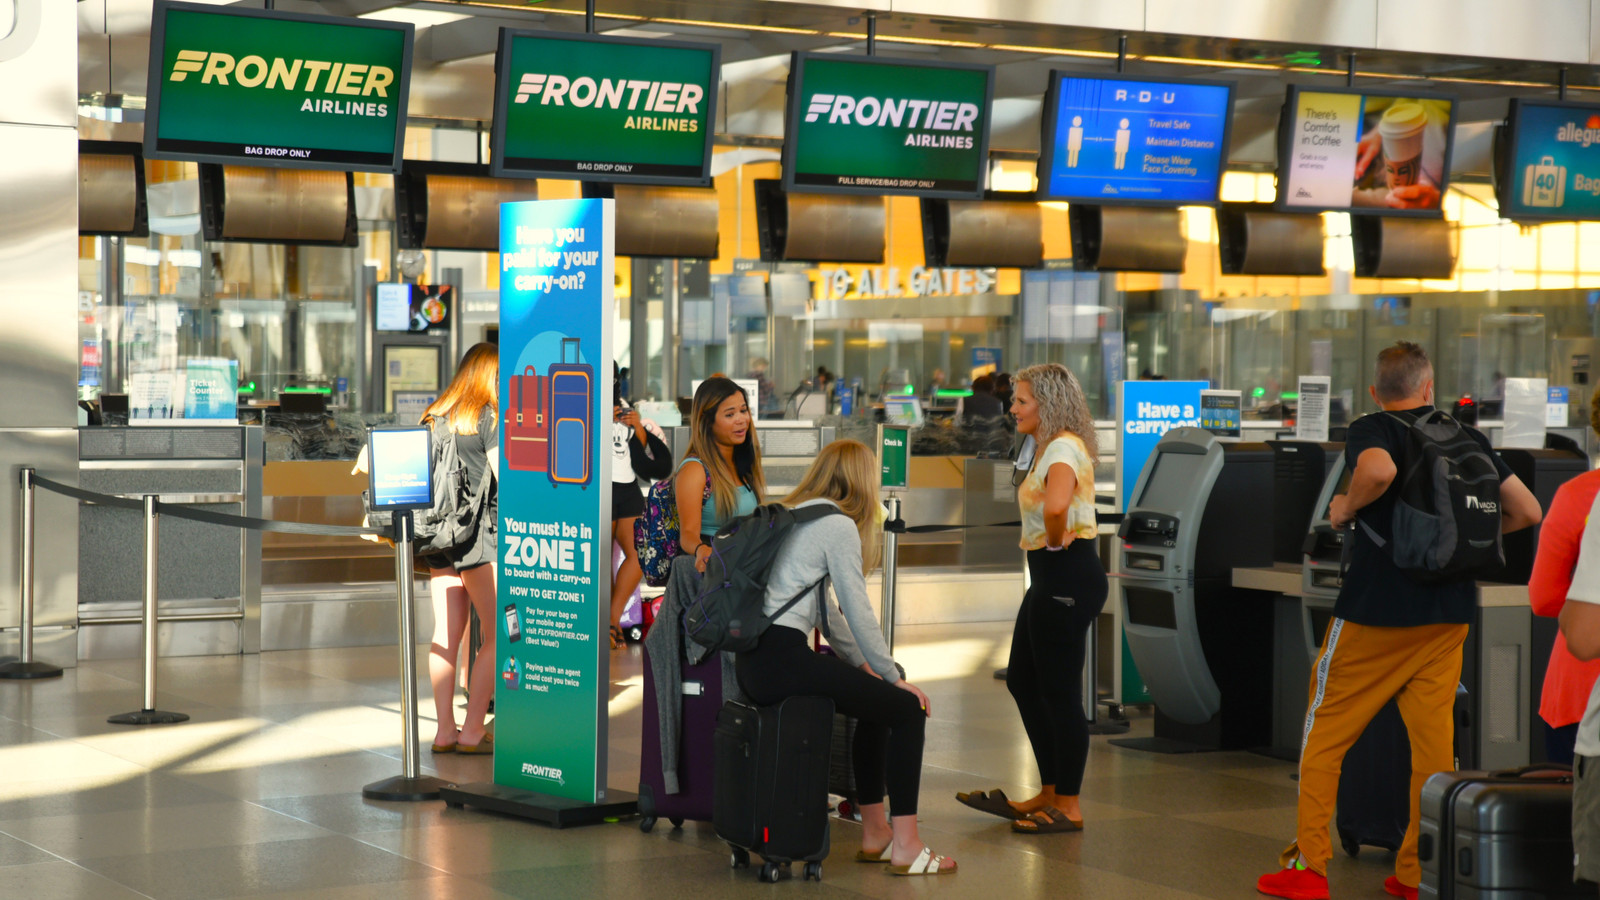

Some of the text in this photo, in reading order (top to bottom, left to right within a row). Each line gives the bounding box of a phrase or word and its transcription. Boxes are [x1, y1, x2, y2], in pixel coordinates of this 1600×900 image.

[170, 49, 394, 98] FRONTIER
[514, 73, 704, 114] FRONTIER
[300, 98, 388, 117] AIRLINES
[805, 94, 978, 131] FRONTIER
[1305, 108, 1337, 120] There's
[624, 116, 698, 132] AIRLINES
[1148, 119, 1191, 130] Travel Safe
[1303, 122, 1340, 133] Comfort
[905, 134, 974, 149] AIRLINES
[1146, 137, 1215, 149] Maintain Distance
[1302, 135, 1341, 147] in Coffee
[245, 146, 311, 158] BAG DROP ONLY
[1144, 155, 1192, 165] Please Wear
[577, 162, 633, 173] BAG DROP ONLY
[1142, 165, 1197, 177] Face Covering
[838, 177, 935, 188] FULL SERVICE/BAG DROP ONLY
[1536, 173, 1555, 190] 40
[516, 226, 584, 247] Have you
[503, 248, 599, 271] paid for your
[514, 271, 586, 294] carry-on?
[858, 268, 902, 296] ALL
[911, 266, 991, 295] GATES
[190, 379, 216, 387] Ticket
[189, 387, 224, 395] Counter
[1138, 402, 1194, 418] Have a
[884, 438, 897, 447] Check
[504, 517, 592, 539] You must be in
[504, 535, 591, 572] ZONE 1
[504, 567, 512, 576] to
[513, 567, 535, 579] board
[536, 570, 552, 581] with
[559, 574, 591, 585] carry-on
[510, 586, 585, 603] HOW TO GET ZONE 1
[526, 607, 535, 616] Pay
[545, 609, 558, 618] your
[559, 610, 569, 620] bag
[536, 618, 554, 627] mobile
[555, 621, 566, 629] app
[525, 637, 540, 645] (Best
[526, 627, 590, 641] visit FLYFRONTIER.COM
[526, 662, 544, 673] Paying
[544, 665, 556, 674] with
[565, 669, 581, 677] agent
[1320, 653, 1330, 674] ADIDAS
[532, 684, 549, 692] much!
[553, 677, 563, 685] you
[565, 678, 579, 687] twice
[521, 762, 562, 779] FRONTIER
